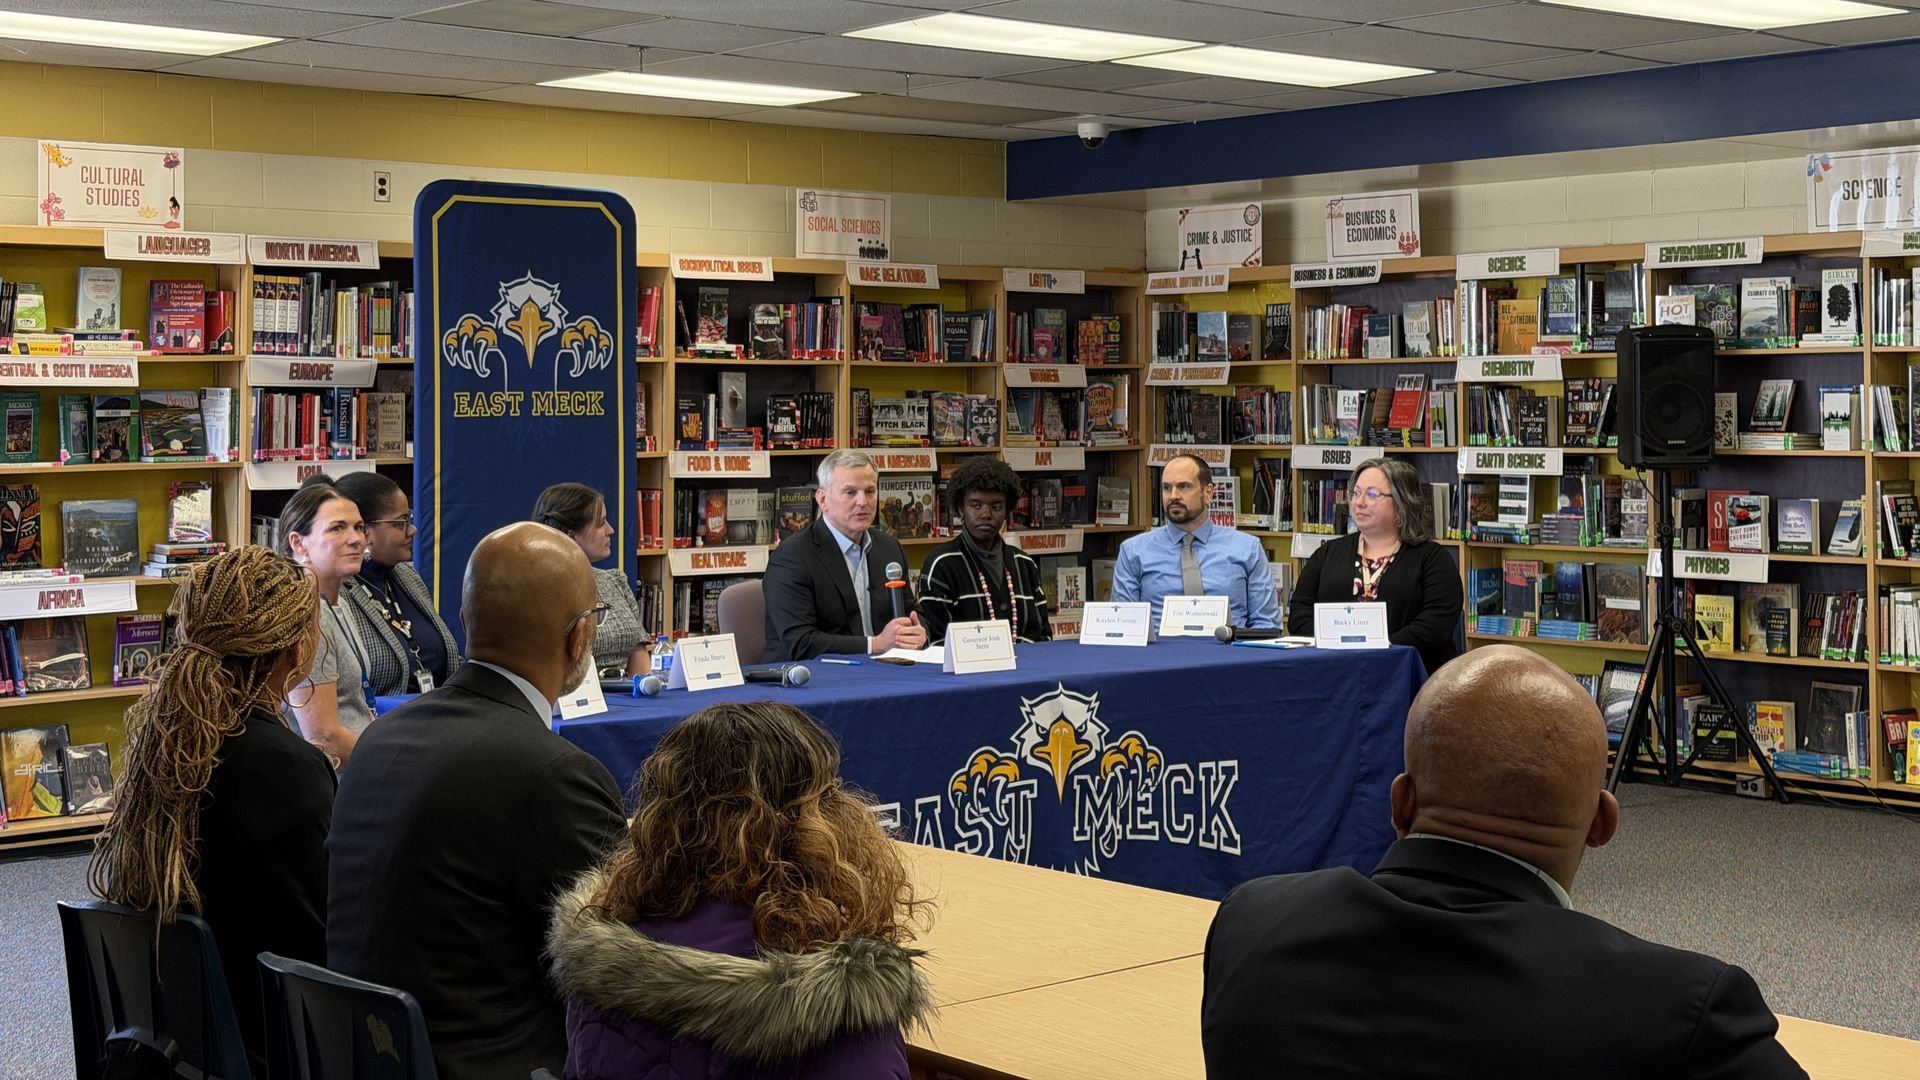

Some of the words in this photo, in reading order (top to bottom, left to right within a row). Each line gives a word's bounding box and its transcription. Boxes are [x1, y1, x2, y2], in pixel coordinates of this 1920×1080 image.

[80, 165, 146, 187] CULTURAL
[86, 187, 140, 208] STUDIES
[807, 216, 839, 233] SOCIAL
[841, 218, 881, 235] SCIENCES
[1345, 210, 1387, 227] BUSINESS
[1389, 209, 1397, 224] &
[1186, 231, 1211, 247] CRIME
[1212, 230, 1218, 245] &
[1221, 228, 1253, 245] JUSTICE
[1346, 226, 1397, 244] ECONOMICS
[138, 235, 211, 257] LANGUAGES
[265, 241, 304, 261] NORTH
[308, 243, 361, 263] AMERICA
[1659, 241, 1748, 264] ENVIRONMENTAL
[678, 259, 736, 274] SOCIOPOLITICAL
[737, 261, 764, 275] ISSUES
[1487, 255, 1527, 273] SCIENCE
[859, 266, 882, 282] RACE
[882, 268, 927, 284] RELATIONS
[1029, 272, 1058, 289] LGBTQ+
[1211, 274, 1226, 287] LAW
[1294, 268, 1327, 283] BUSINESS
[1328, 267, 1336, 281] &
[1336, 265, 1378, 280] ECONOMICS
[1828, 271, 1856, 279] SIBLEY
[1501, 304, 1511, 314] BEE
[1660, 303, 1690, 318] HOT
[1706, 301, 1733, 313] Care
[1711, 309, 1733, 320] free
[1510, 314, 1538, 325] CATHEDRAL
[946, 327, 968, 335] EQUAL
[42, 363, 50, 377] &
[53, 363, 86, 378] SOUTH
[89, 364, 134, 378] AMERICA
[289, 362, 334, 381] EUROPE
[1029, 368, 1061, 383] WOMEN
[1481, 360, 1535, 377] CHEMISTRY
[8, 401, 32, 409] MEXICO
[454, 391, 524, 418] EAST
[532, 391, 605, 418] MECK
[1342, 395, 1358, 406] FLA
[339, 394, 351, 438] Russian
[778, 416, 791, 426] CIVIL
[972, 415, 998, 424] Caste
[774, 424, 797, 433] LIBERTIES
[875, 420, 899, 430] PITCH
[901, 420, 927, 430] BLACK
[687, 456, 711, 471] FOOD
[714, 456, 722, 471] &
[724, 456, 751, 471] HOME
[887, 454, 931, 469] AMERICANS
[1321, 450, 1352, 465] ISSUES
[1476, 453, 1504, 469] EARTH
[1507, 453, 1546, 470] SCIENCE
[885, 480, 931, 491] UNDEFEATED
[781, 492, 811, 502] stuffed
[1211, 514, 1236, 527] STICE
[1784, 514, 1804, 523] Eating
[1793, 521, 1806, 529] Sun
[1020, 533, 1066, 549] IMMIGRANTS
[1729, 531, 1760, 542] CHERNOBYL
[691, 551, 747, 569] HEALTHCARE
[1684, 555, 1730, 575] PHYSICS
[1066, 575, 1079, 588] WE
[38, 588, 85, 611] AFRICA
[1064, 588, 1080, 602] ARE
[962, 636, 988, 644] Governor
[1748, 724, 1782, 736] POWER
[1888, 721, 1908, 741] BRA
[1753, 734, 1770, 743] RIP
[1073, 760, 1242, 856] MECK
